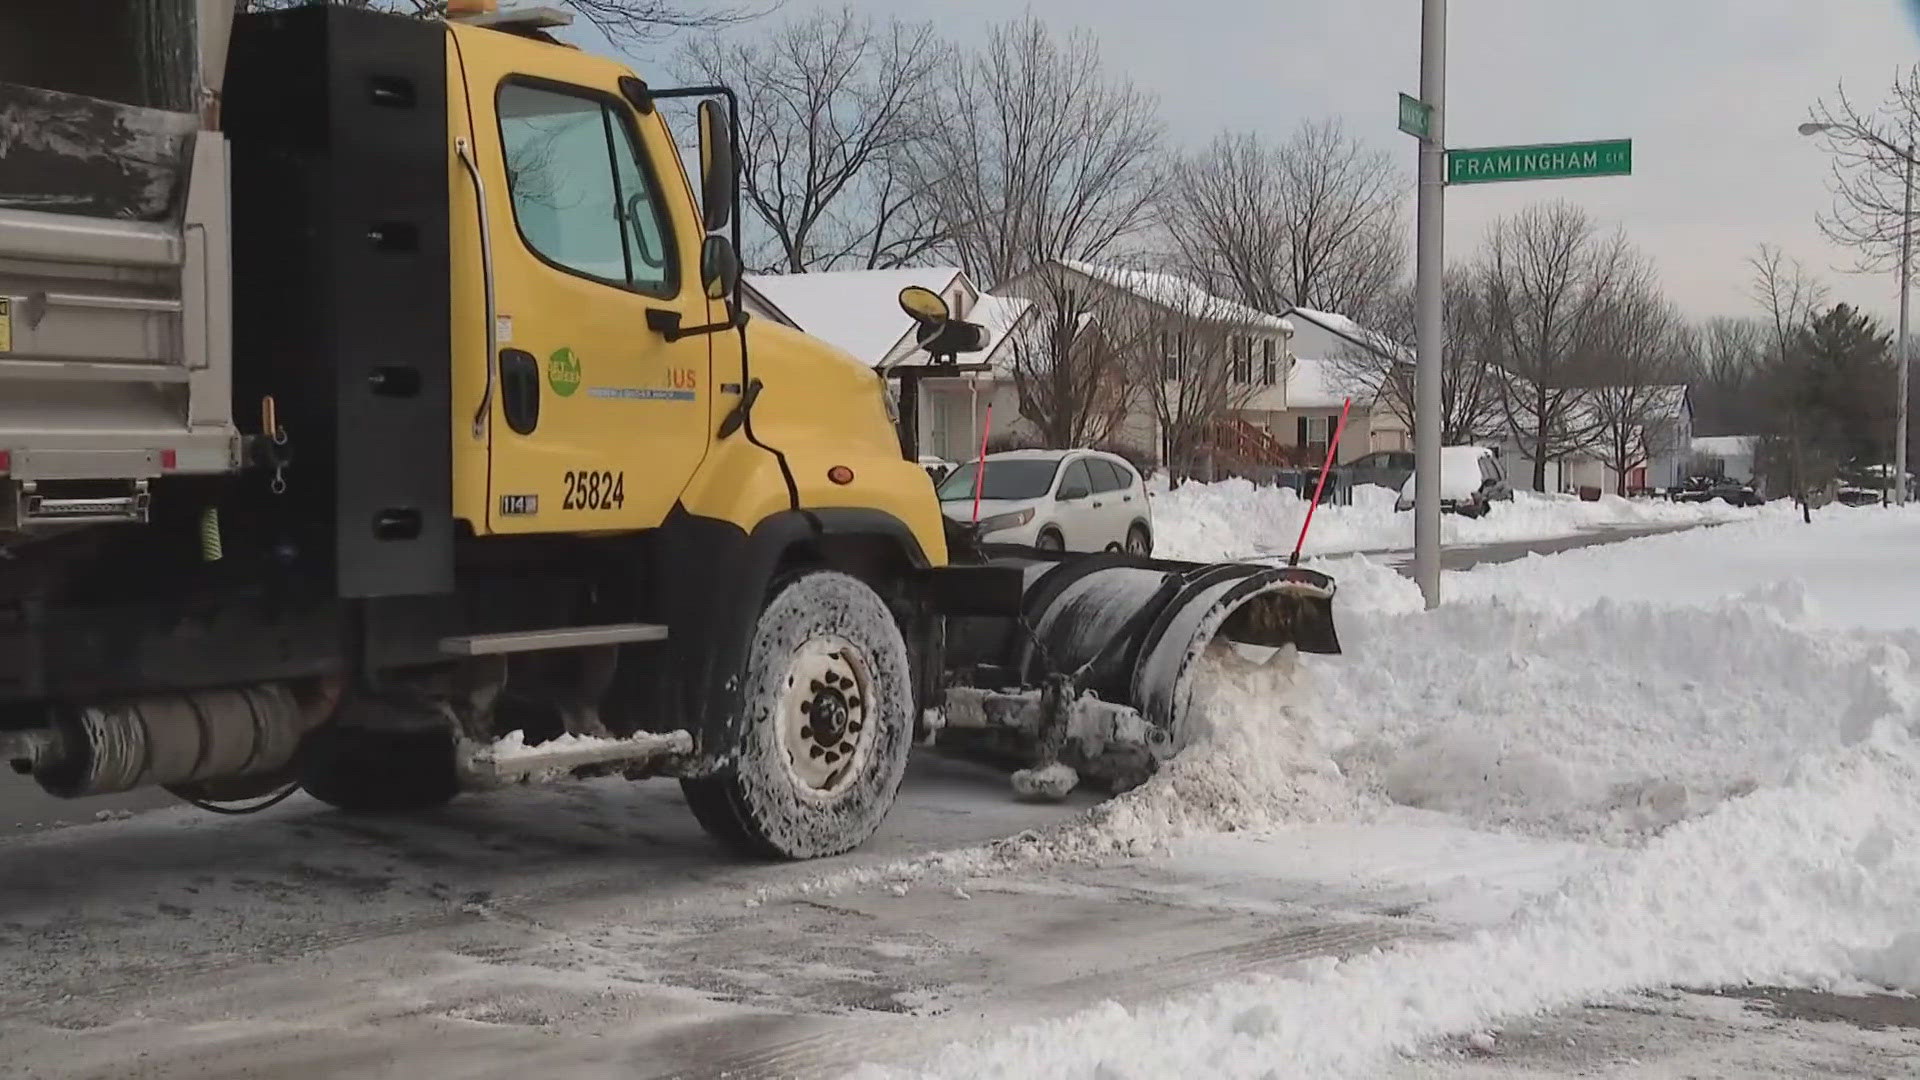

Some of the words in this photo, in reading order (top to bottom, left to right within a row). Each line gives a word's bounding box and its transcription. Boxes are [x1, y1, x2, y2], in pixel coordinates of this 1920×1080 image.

[1454, 151, 1598, 176] FRAMINGHAM
[562, 471, 625, 510] 25824
[504, 496, 524, 513] 114
